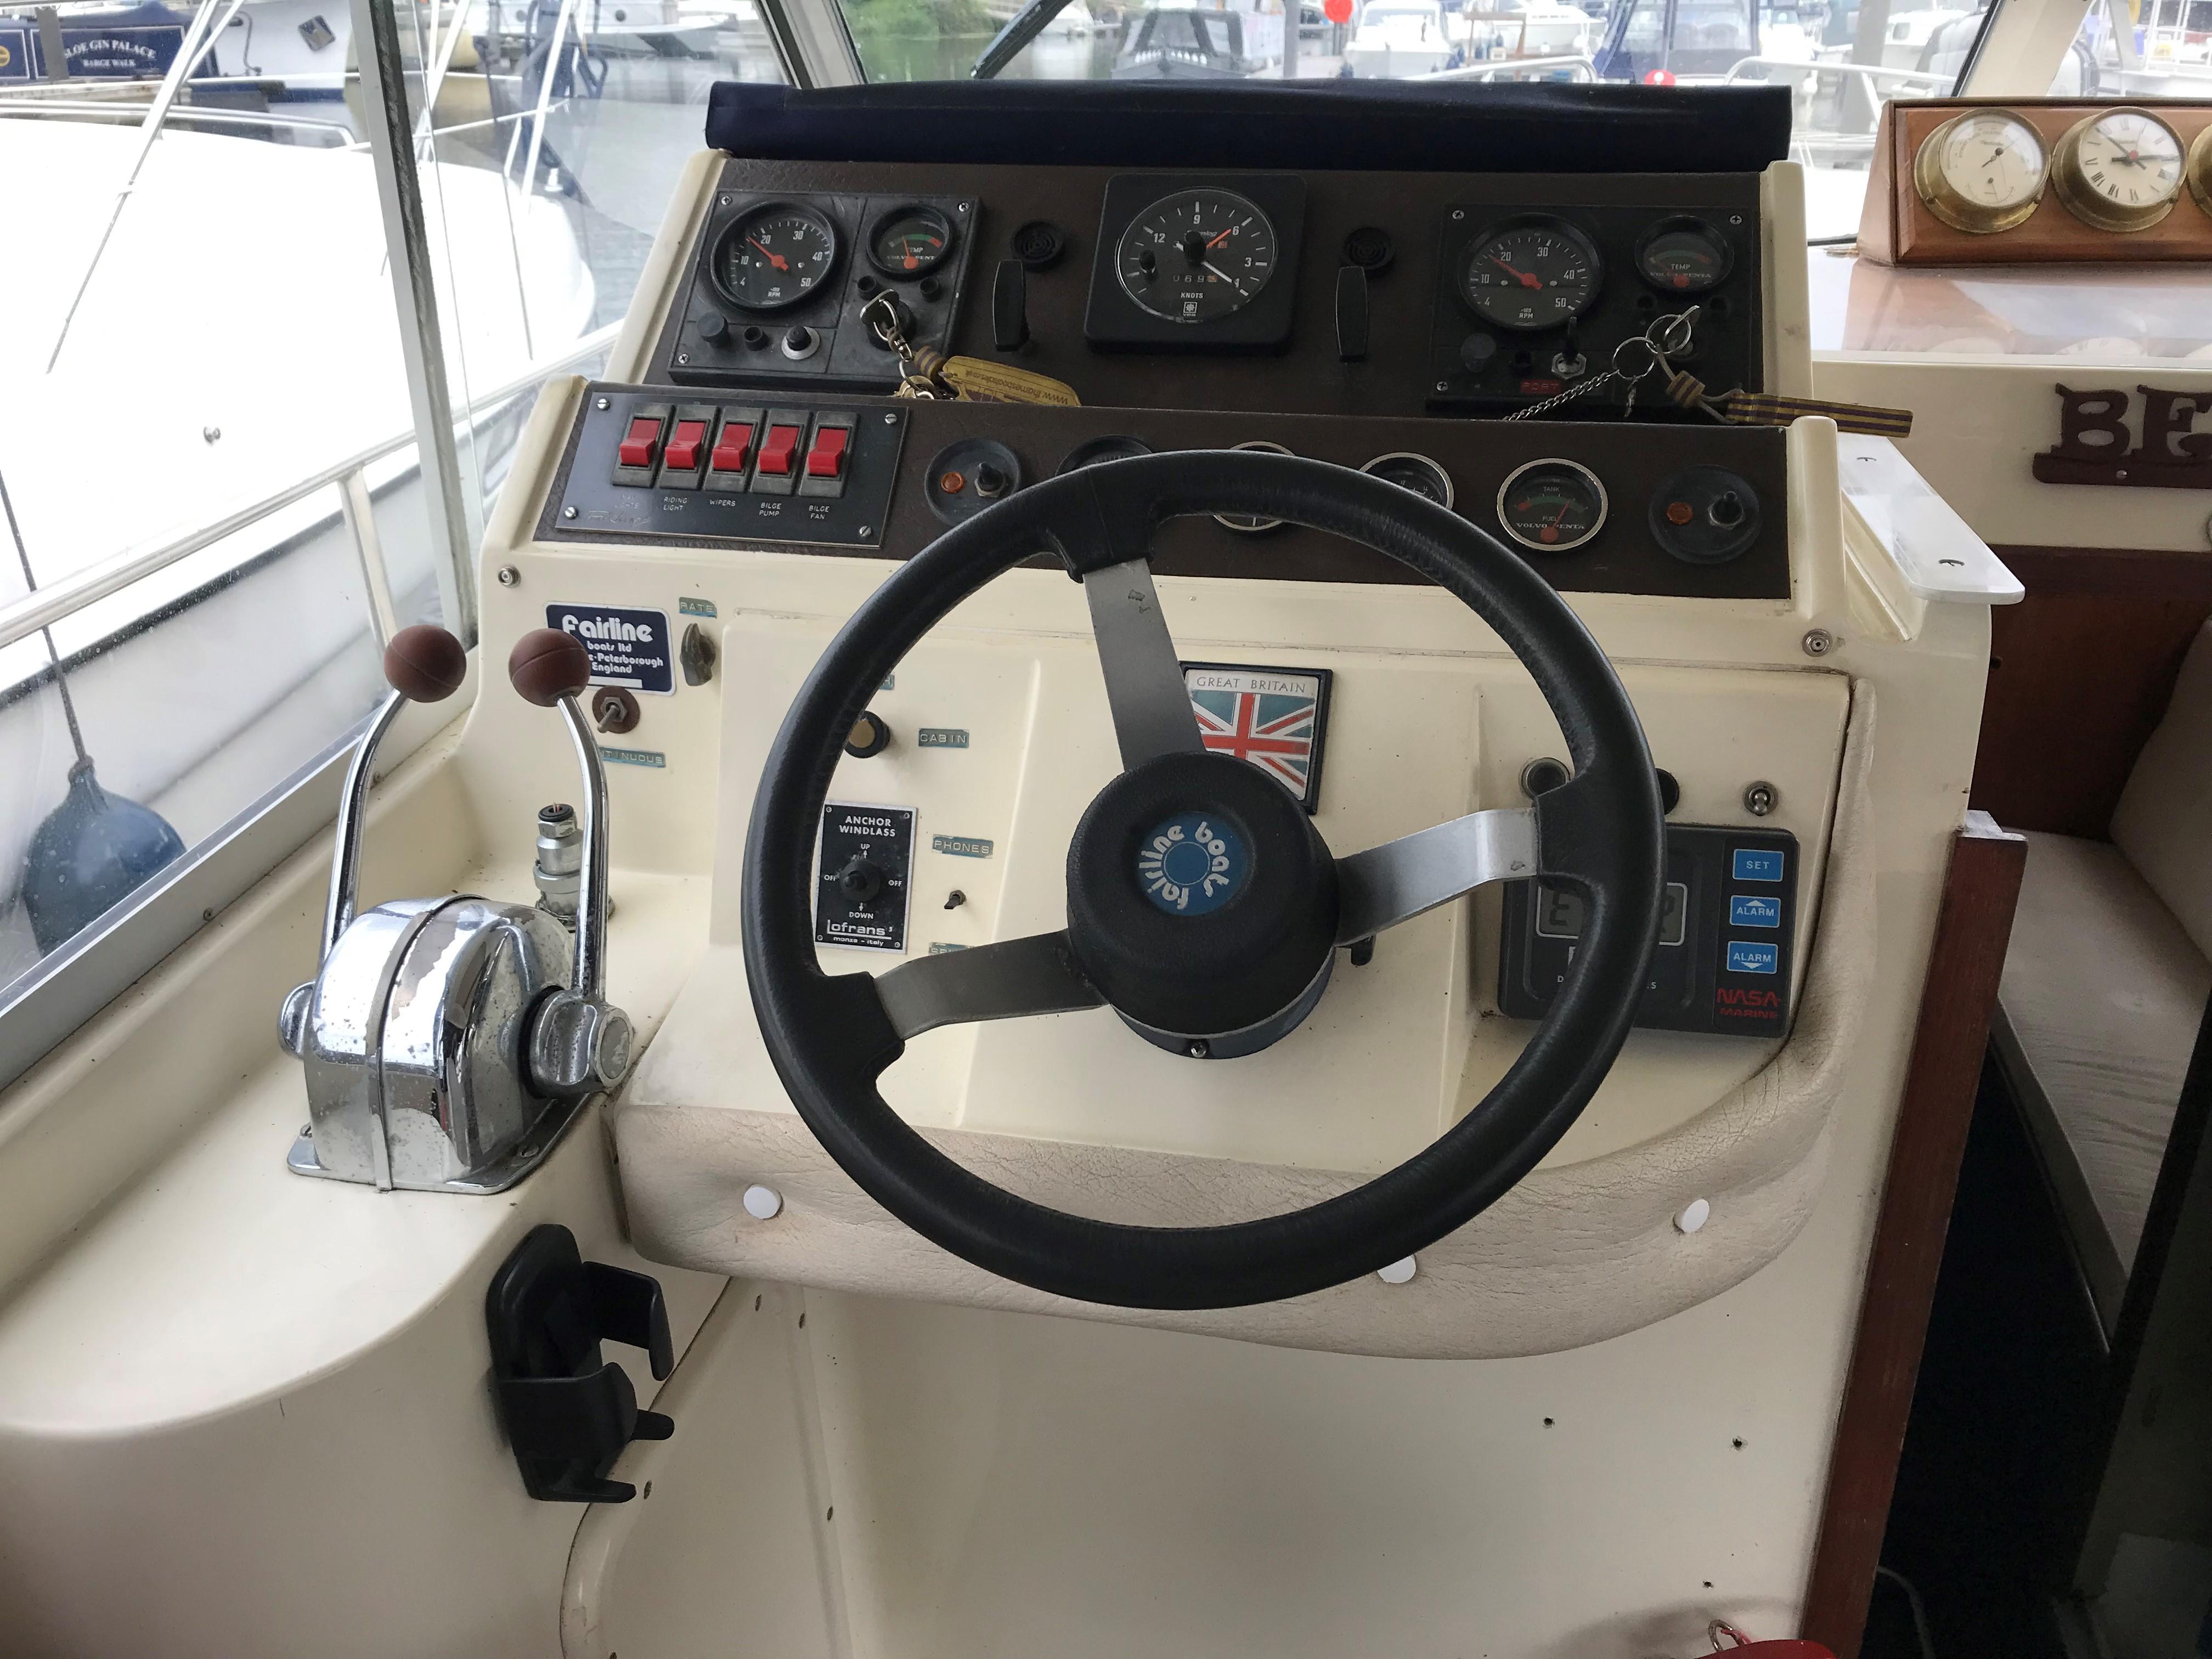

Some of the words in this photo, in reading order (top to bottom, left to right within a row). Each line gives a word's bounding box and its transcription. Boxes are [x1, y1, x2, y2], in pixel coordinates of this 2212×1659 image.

[89, 40, 110, 51] GIN
[111, 40, 156, 60] PALACE
[1193, 215, 1200, 224] 9
[793, 230, 803, 240] 30
[1232, 225, 1239, 235] 6
[760, 235, 771, 244] 20
[1153, 233, 1166, 242] 12
[812, 252, 822, 261] 40
[1501, 252, 1511, 261] 20
[1537, 247, 1548, 257] 30
[741, 256, 749, 264] 10
[1244, 257, 1252, 267] 3
[1481, 274, 1489, 283] 10
[1564, 270, 1575, 279] 40
[740, 277, 746, 285] 4
[800, 278, 811, 286] 50
[1485, 297, 1490, 306] 4
[1555, 298, 1566, 307] 50
[680, 602, 714, 612] RATE
[586, 641, 614, 651] boats
[618, 642, 631, 652] ltd
[592, 662, 631, 674] England
[1197, 677, 1240, 688] GREAT
[1251, 679, 1305, 693] BRITAIN
[921, 734, 966, 743] CABIN
[845, 816, 891, 827] ANCHOR
[839, 825, 896, 837] WINDLASS
[934, 840, 990, 854] PHONES
[1139, 825, 1189, 910] fairline
[1195, 821, 1229, 898] boats
[1746, 861, 1769, 870] SET
[849, 911, 874, 919] DOWN
[1736, 906, 1775, 917] ALARM
[1733, 952, 1771, 963] ALARM
[1717, 988, 1782, 1007] NASA
[1720, 1007, 1778, 1019] MARINE
